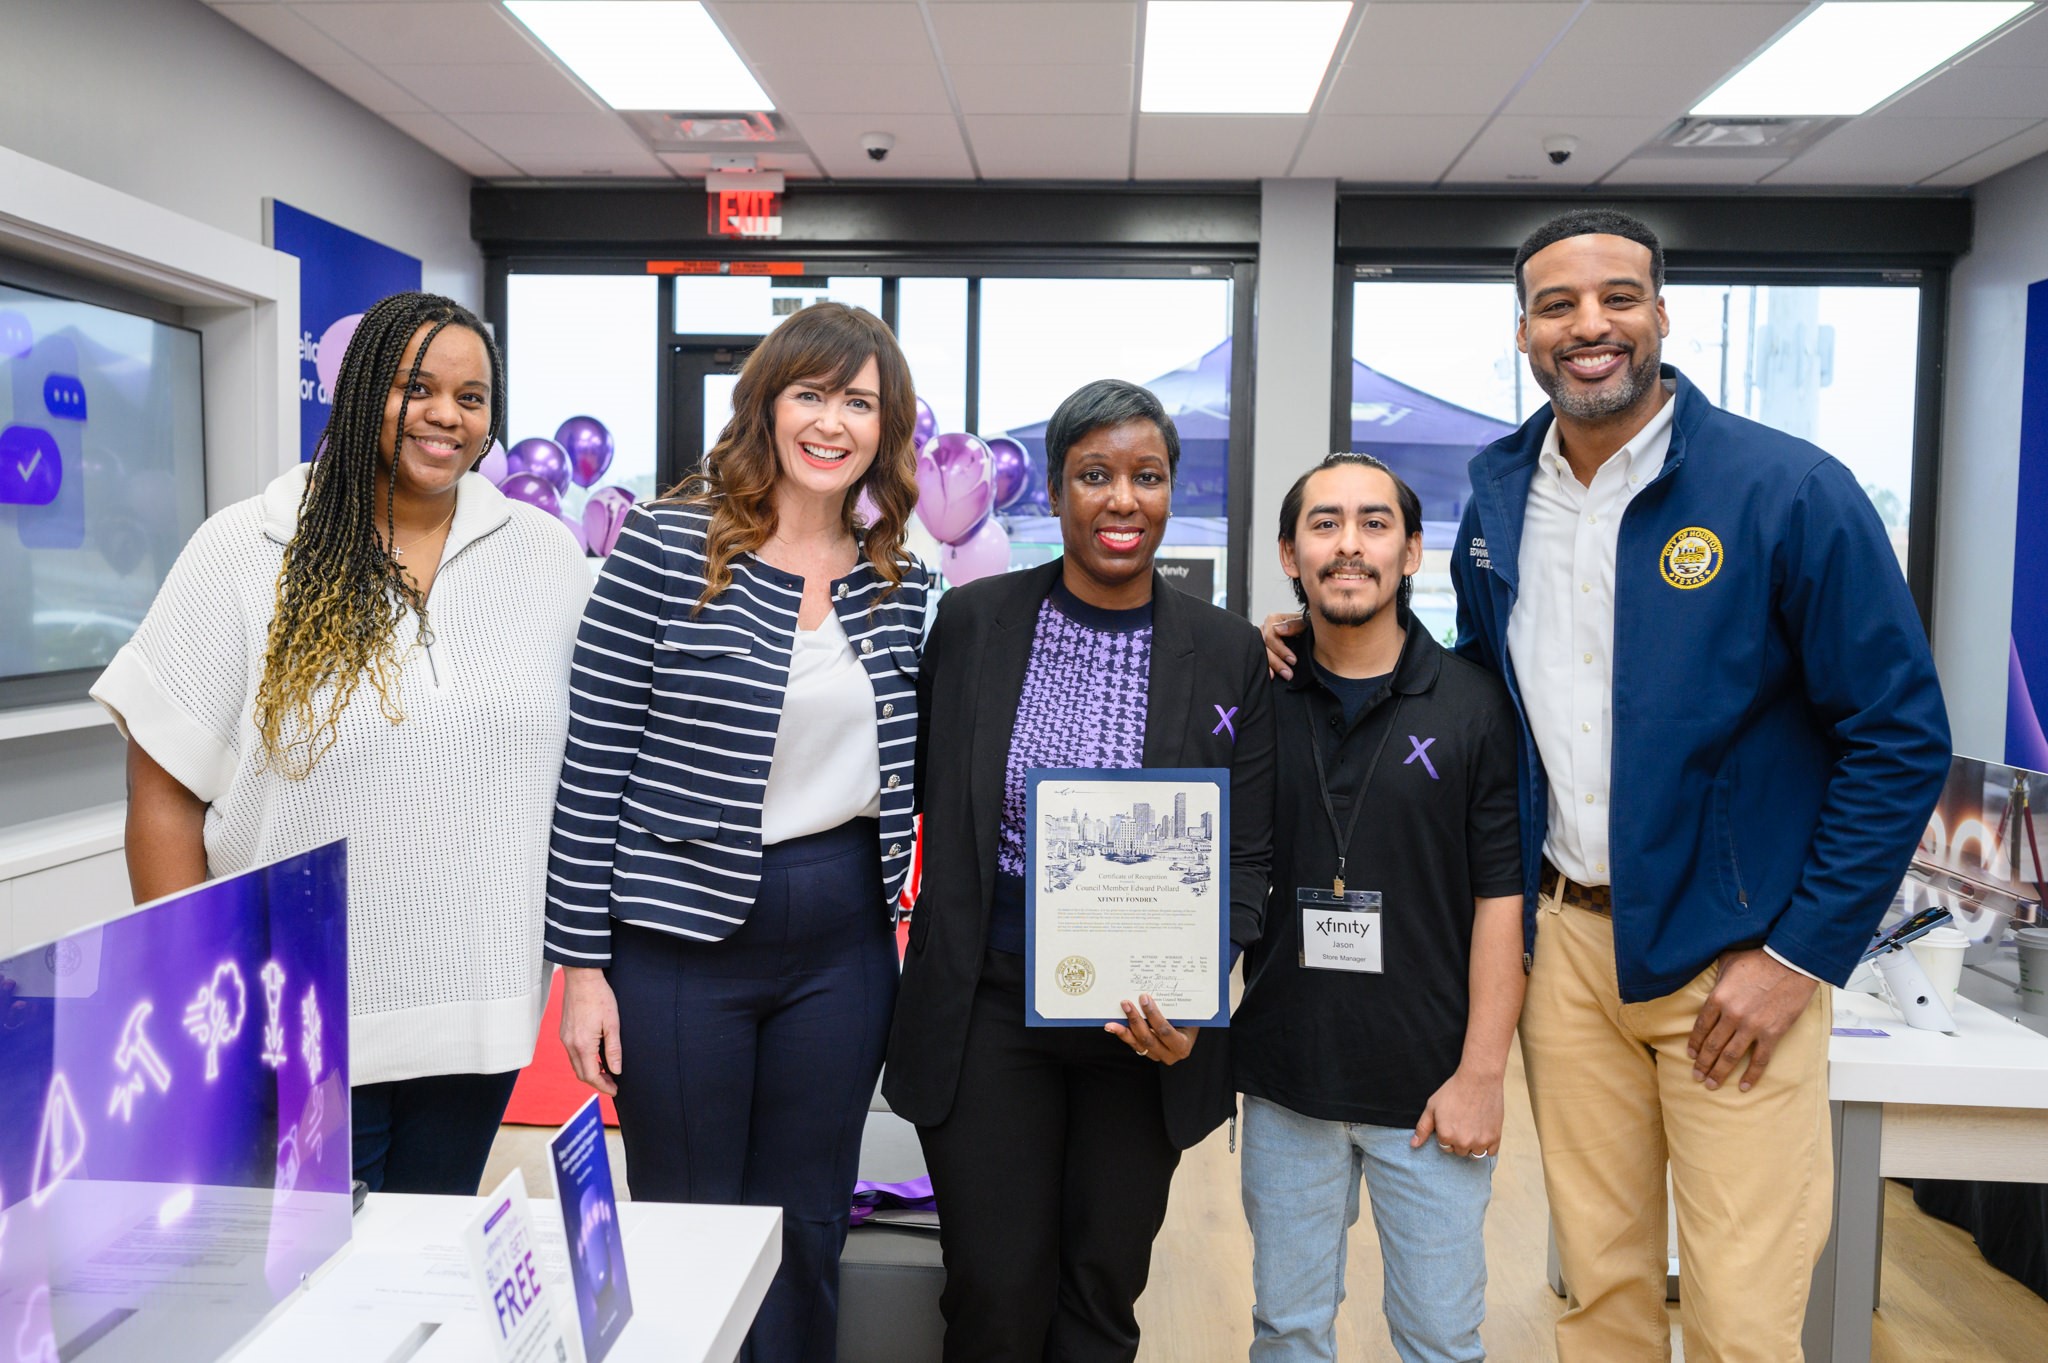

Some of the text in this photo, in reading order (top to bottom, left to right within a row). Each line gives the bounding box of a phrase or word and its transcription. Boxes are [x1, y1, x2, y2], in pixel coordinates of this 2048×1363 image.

[719, 191, 774, 234] EXIT
[1665, 530, 1719, 556] CITY OF HOUSTON
[1673, 574, 1706, 585] TEXAS
[1098, 872, 1127, 880] Certificate
[1135, 873, 1168, 881] Recognition
[1075, 884, 1101, 892] Council
[1102, 884, 1129, 892] Member
[1130, 884, 1155, 892] Edward
[1316, 917, 1370, 938] xfinity
[1333, 940, 1354, 949] Jason
[1322, 953, 1366, 963] Store Manager
[494, 1250, 542, 1340] FREE
